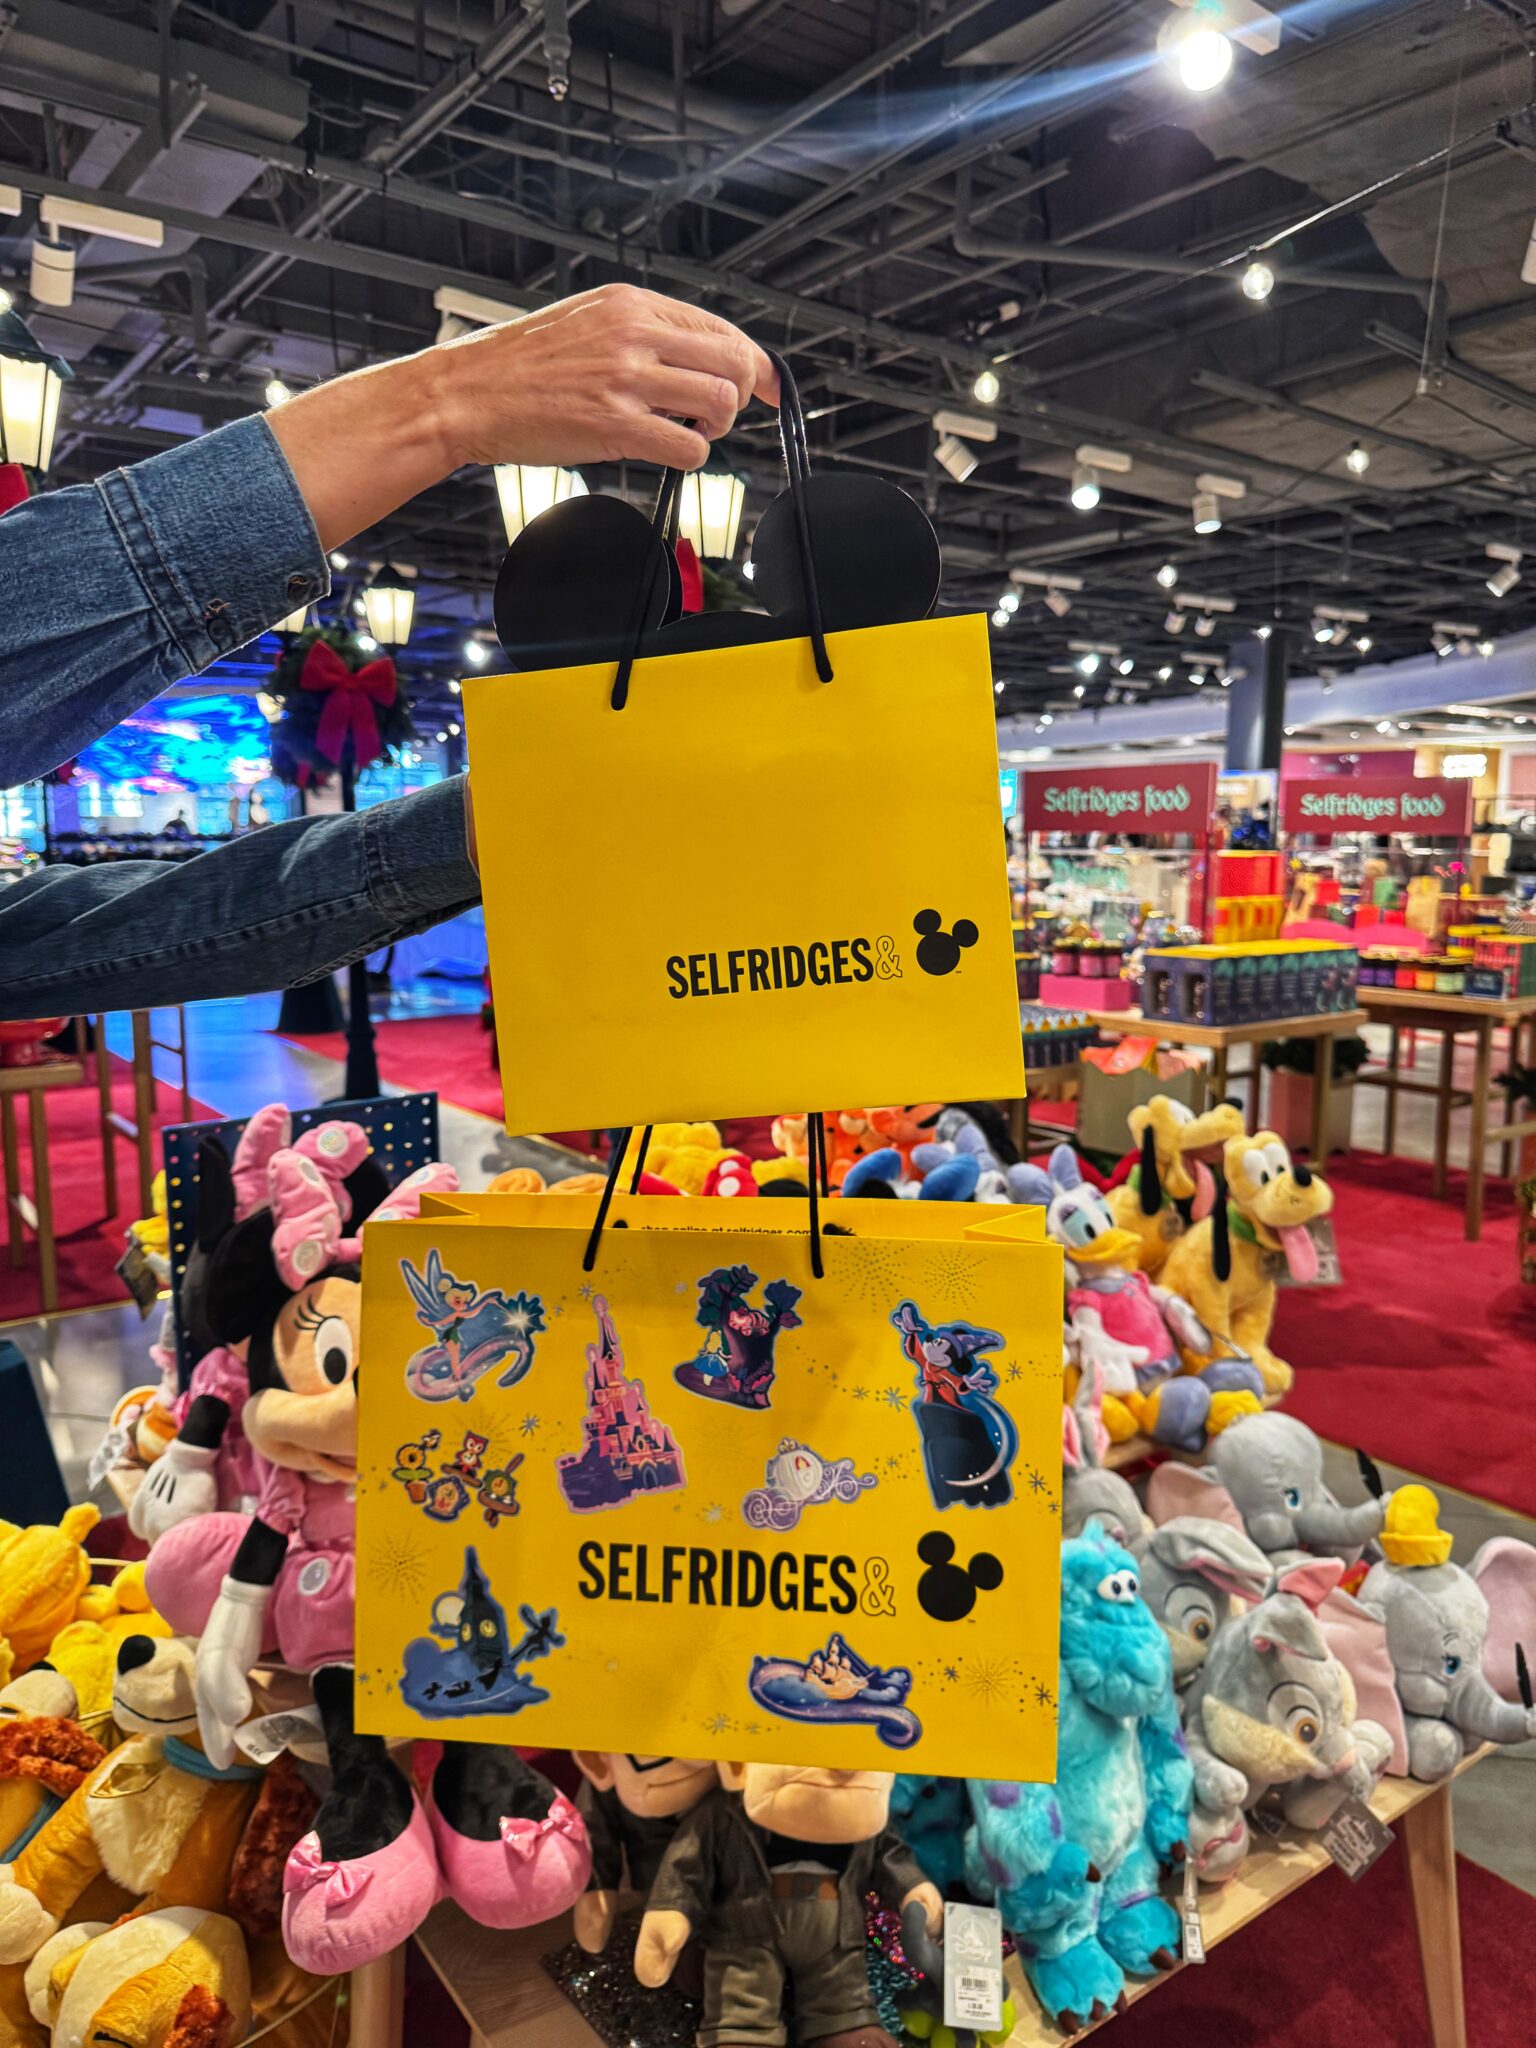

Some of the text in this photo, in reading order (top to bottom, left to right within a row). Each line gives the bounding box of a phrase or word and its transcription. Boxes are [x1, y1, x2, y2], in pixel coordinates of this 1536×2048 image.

[1043, 785, 1141, 818] Selfridges
[1144, 783, 1191, 818] food
[1299, 792, 1446, 821] Selfridges food
